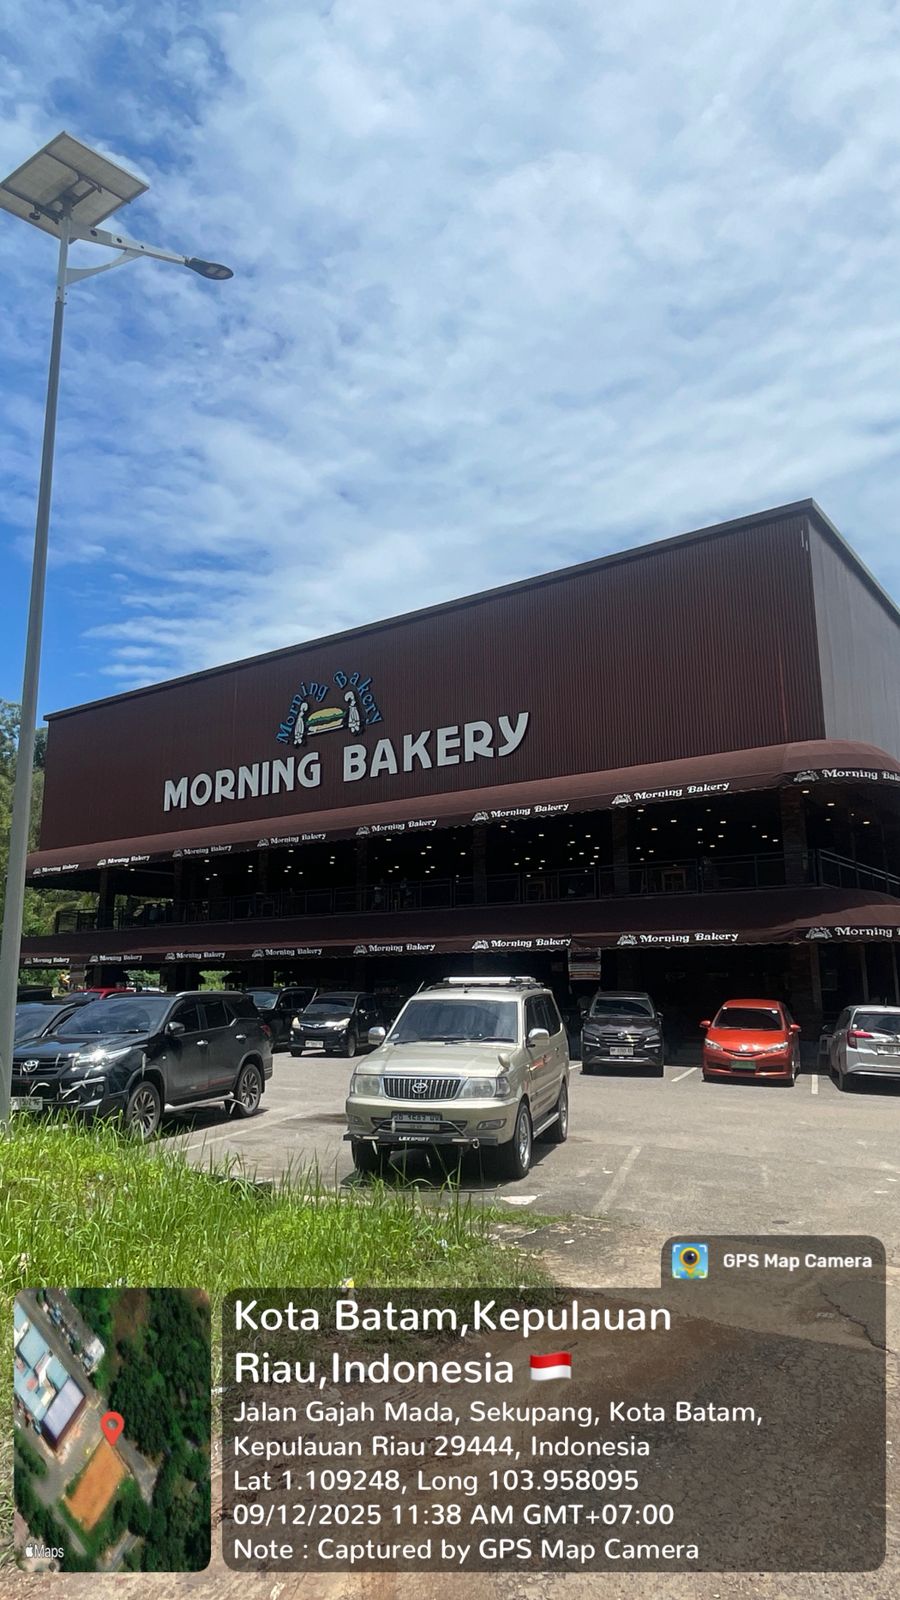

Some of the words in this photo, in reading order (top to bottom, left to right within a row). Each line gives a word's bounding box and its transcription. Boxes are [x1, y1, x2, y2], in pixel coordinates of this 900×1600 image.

[276, 681, 329, 744] Morning
[333, 671, 382, 725] Bakery
[163, 752, 321, 812] MORNING
[343, 712, 529, 782] BAKERY
[822, 768, 878, 780] Morning
[633, 788, 683, 801] Morning
[687, 781, 730, 794] Bakery
[490, 807, 531, 818] Morning
[534, 802, 569, 813] Bakery
[371, 823, 405, 833] Morning
[408, 818, 437, 828] Bakery
[270, 835, 299, 844] Morning
[301, 833, 326, 841] Bakery
[183, 848, 209, 856] Morning
[210, 844, 232, 853] Bakery
[639, 933, 690, 944] Morning
[694, 931, 739, 942] Bakery
[834, 926, 893, 938] Morning
[368, 944, 403, 953] Morning
[406, 943, 436, 951] Bakery
[490, 938, 532, 948] Morning
[535, 937, 571, 947] Bakery
[176, 951, 201, 960] Morning
[203, 951, 226, 959] Bakery
[265, 948, 295, 956] Morning
[297, 948, 322, 956] Bakery
